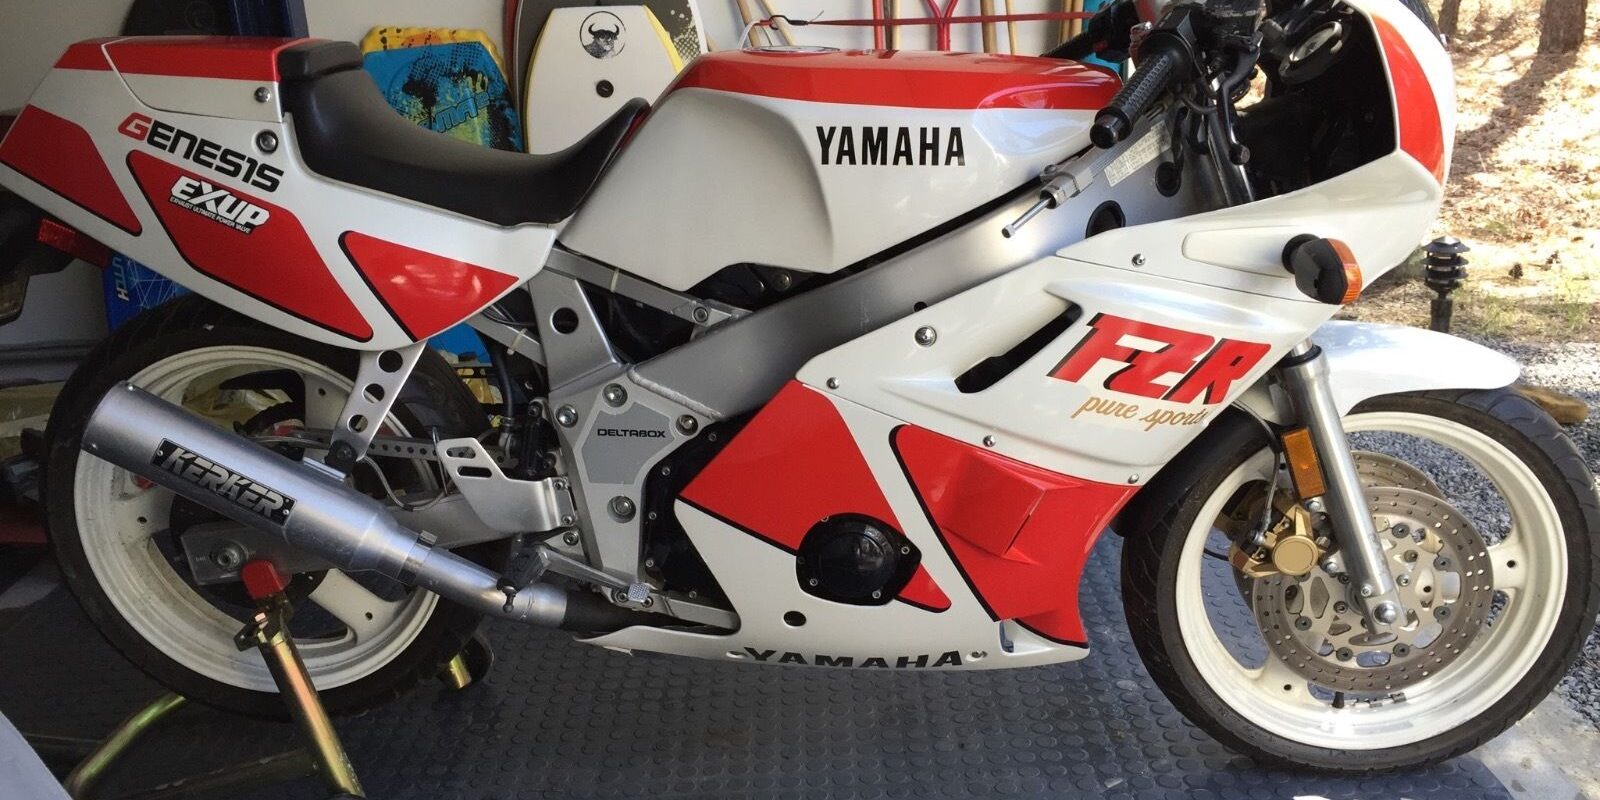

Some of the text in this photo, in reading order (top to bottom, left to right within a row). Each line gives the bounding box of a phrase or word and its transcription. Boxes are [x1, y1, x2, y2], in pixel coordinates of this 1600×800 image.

[117, 112, 284, 192] GENESIS
[816, 126, 965, 166] YAMAHA
[171, 175, 270, 226] EXUP
[192, 205, 216, 220] ULTIMATE
[215, 214, 236, 228] POWER
[235, 222, 252, 234] VALVE
[1046, 312, 1272, 405] FZR
[1070, 396, 1140, 419] pure
[597, 428, 666, 438] DELTABOX
[161, 447, 284, 518] KERKER
[743, 646, 963, 668] YAMAHA
